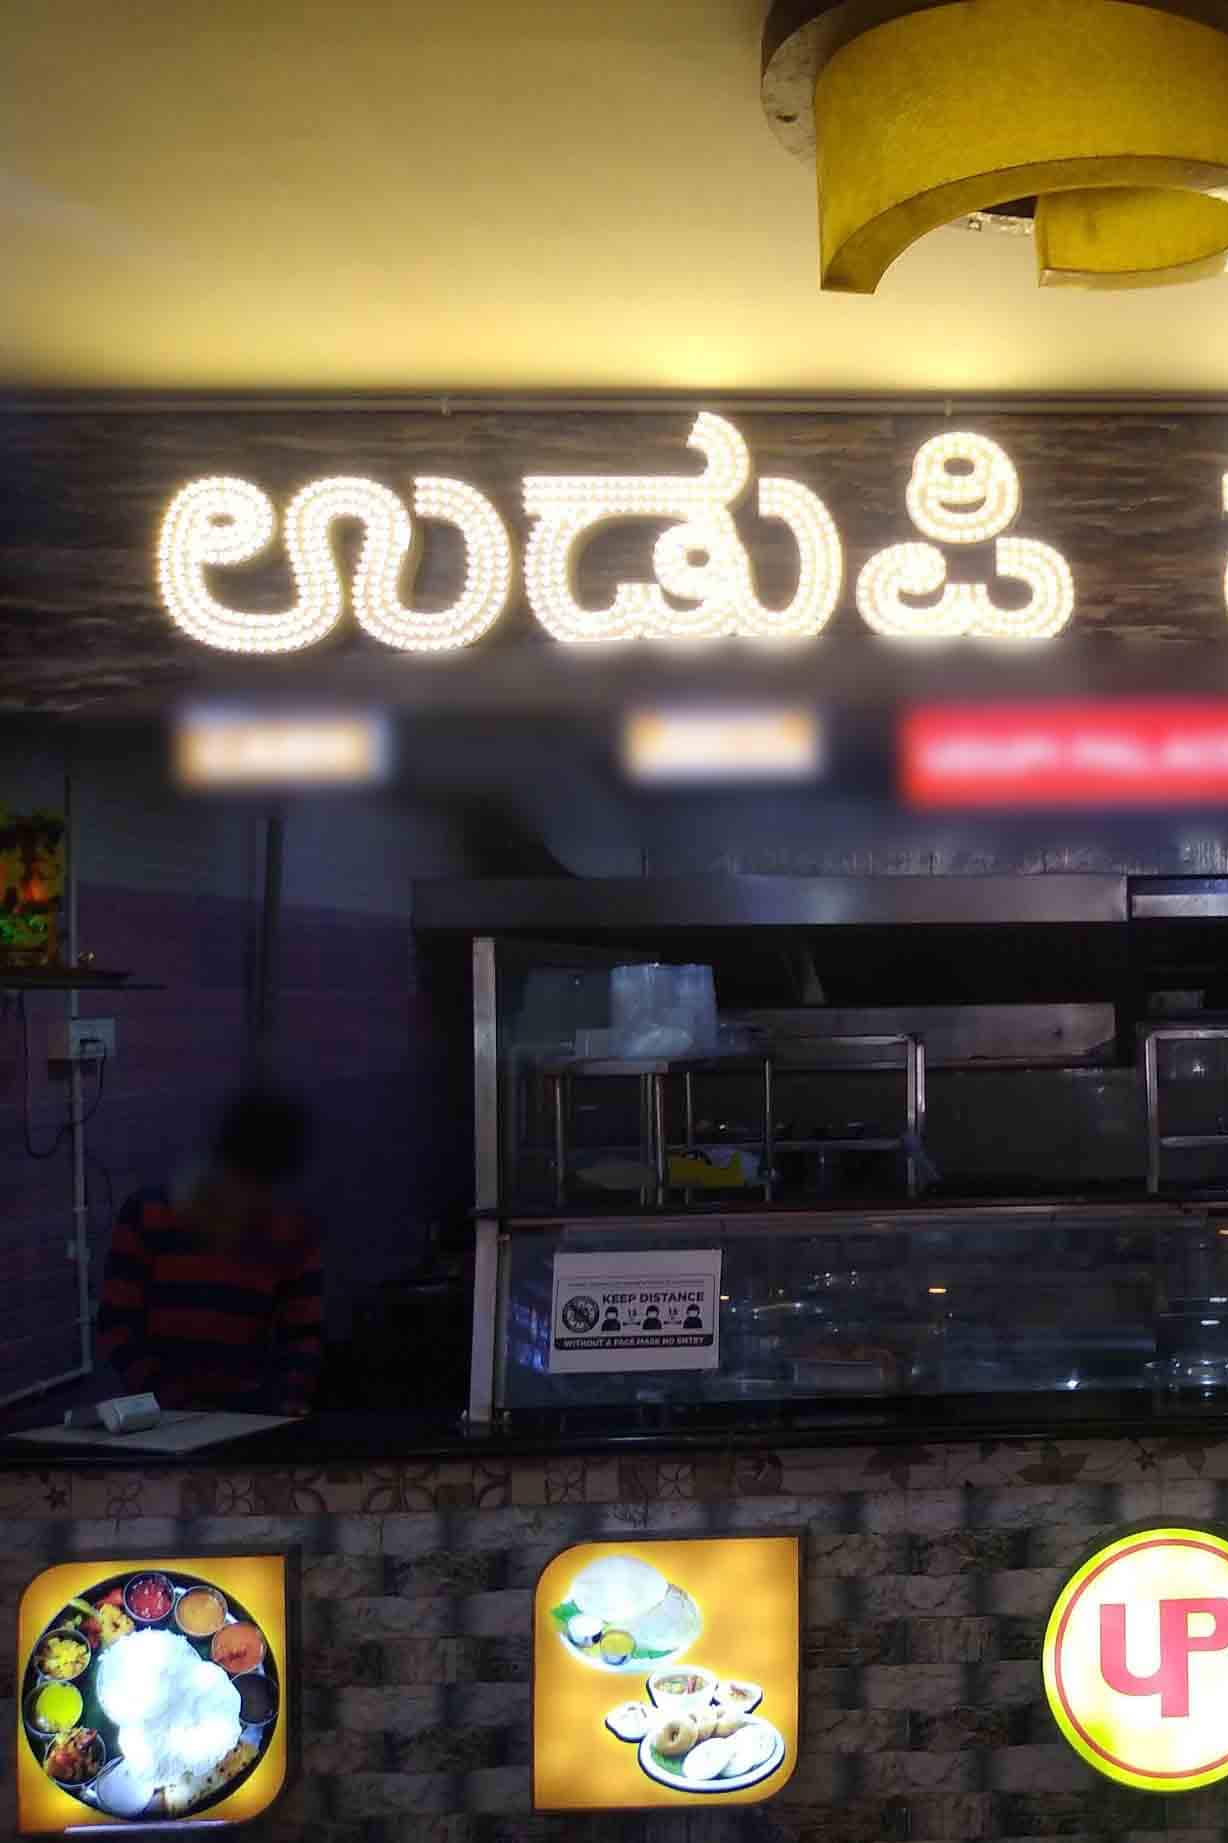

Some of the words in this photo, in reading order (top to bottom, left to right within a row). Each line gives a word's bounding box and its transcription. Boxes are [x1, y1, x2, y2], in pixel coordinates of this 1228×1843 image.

[156, 411, 1077, 653] ಉಡುಪಿ
[602, 1293, 638, 1304] KEEP
[639, 1291, 705, 1303] DISTANCE
